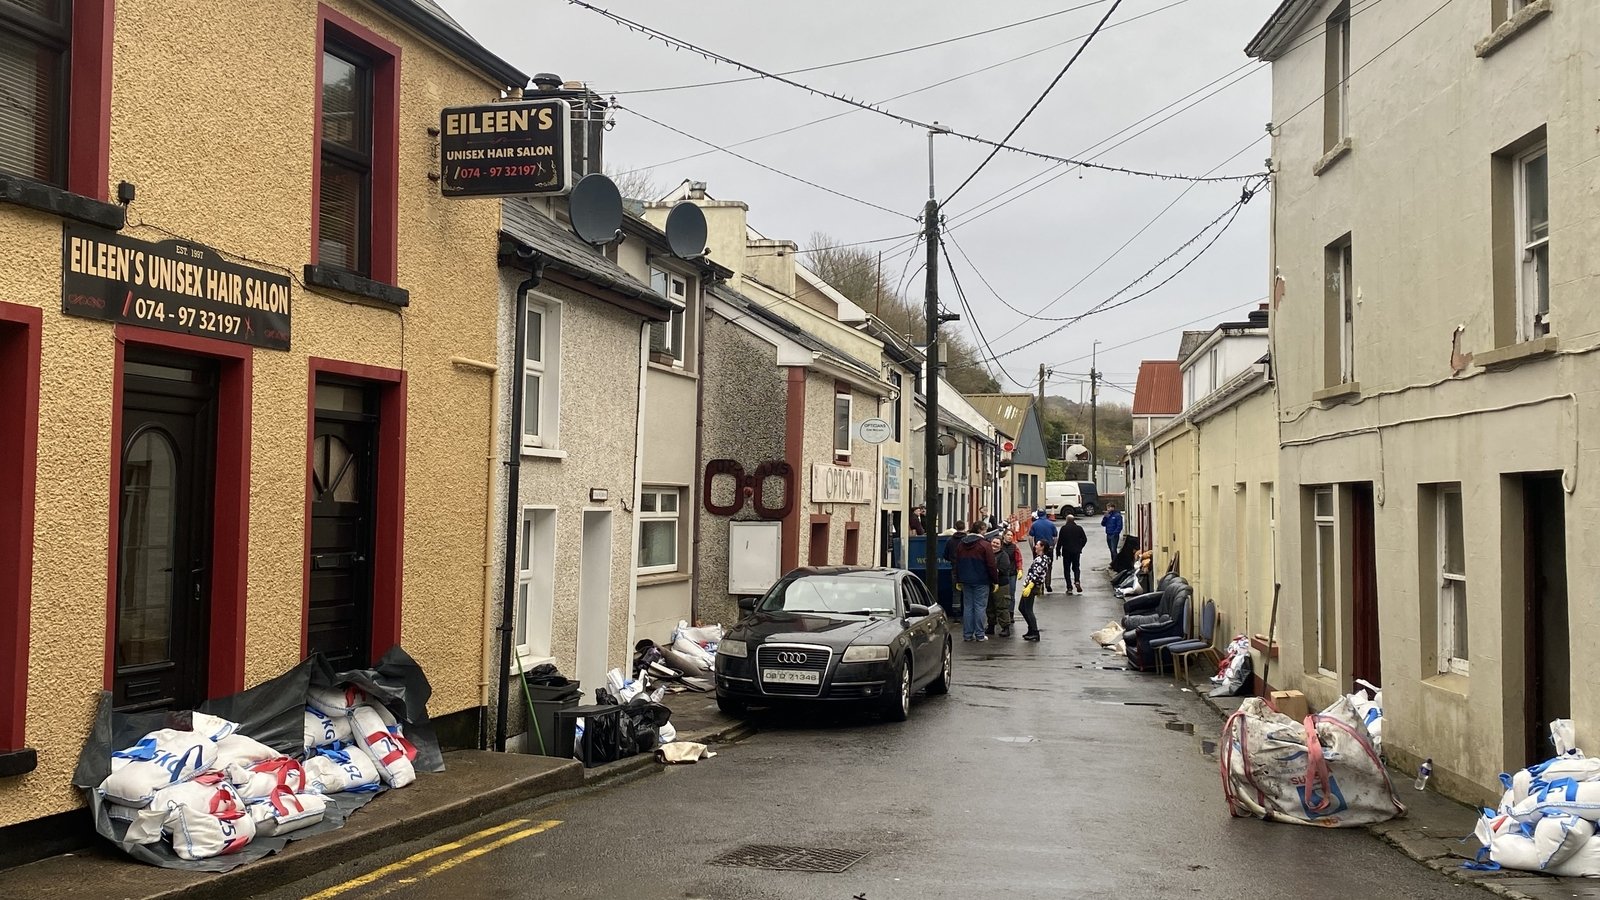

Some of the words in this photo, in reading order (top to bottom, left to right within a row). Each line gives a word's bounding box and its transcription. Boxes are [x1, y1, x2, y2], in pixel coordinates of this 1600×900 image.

[446, 107, 553, 136] EILEEN'S
[447, 149, 485, 161] UNISEX
[487, 147, 515, 159] HAIR
[516, 145, 553, 157] SALON
[461, 167, 481, 179] 074
[489, 166, 503, 178] 97
[504, 164, 537, 177] 32197
[176, 245, 189, 256] EST.
[191, 248, 204, 260] 1997
[71, 236, 144, 285] EILEEN'S
[148, 254, 204, 298] UNISEX
[206, 268, 243, 306] HAIR
[245, 277, 289, 315] SALON
[135, 297, 165, 322] 074
[178, 306, 197, 328] 97
[199, 310, 241, 335] 32197
[826, 467, 864, 501] OPTICIAN
